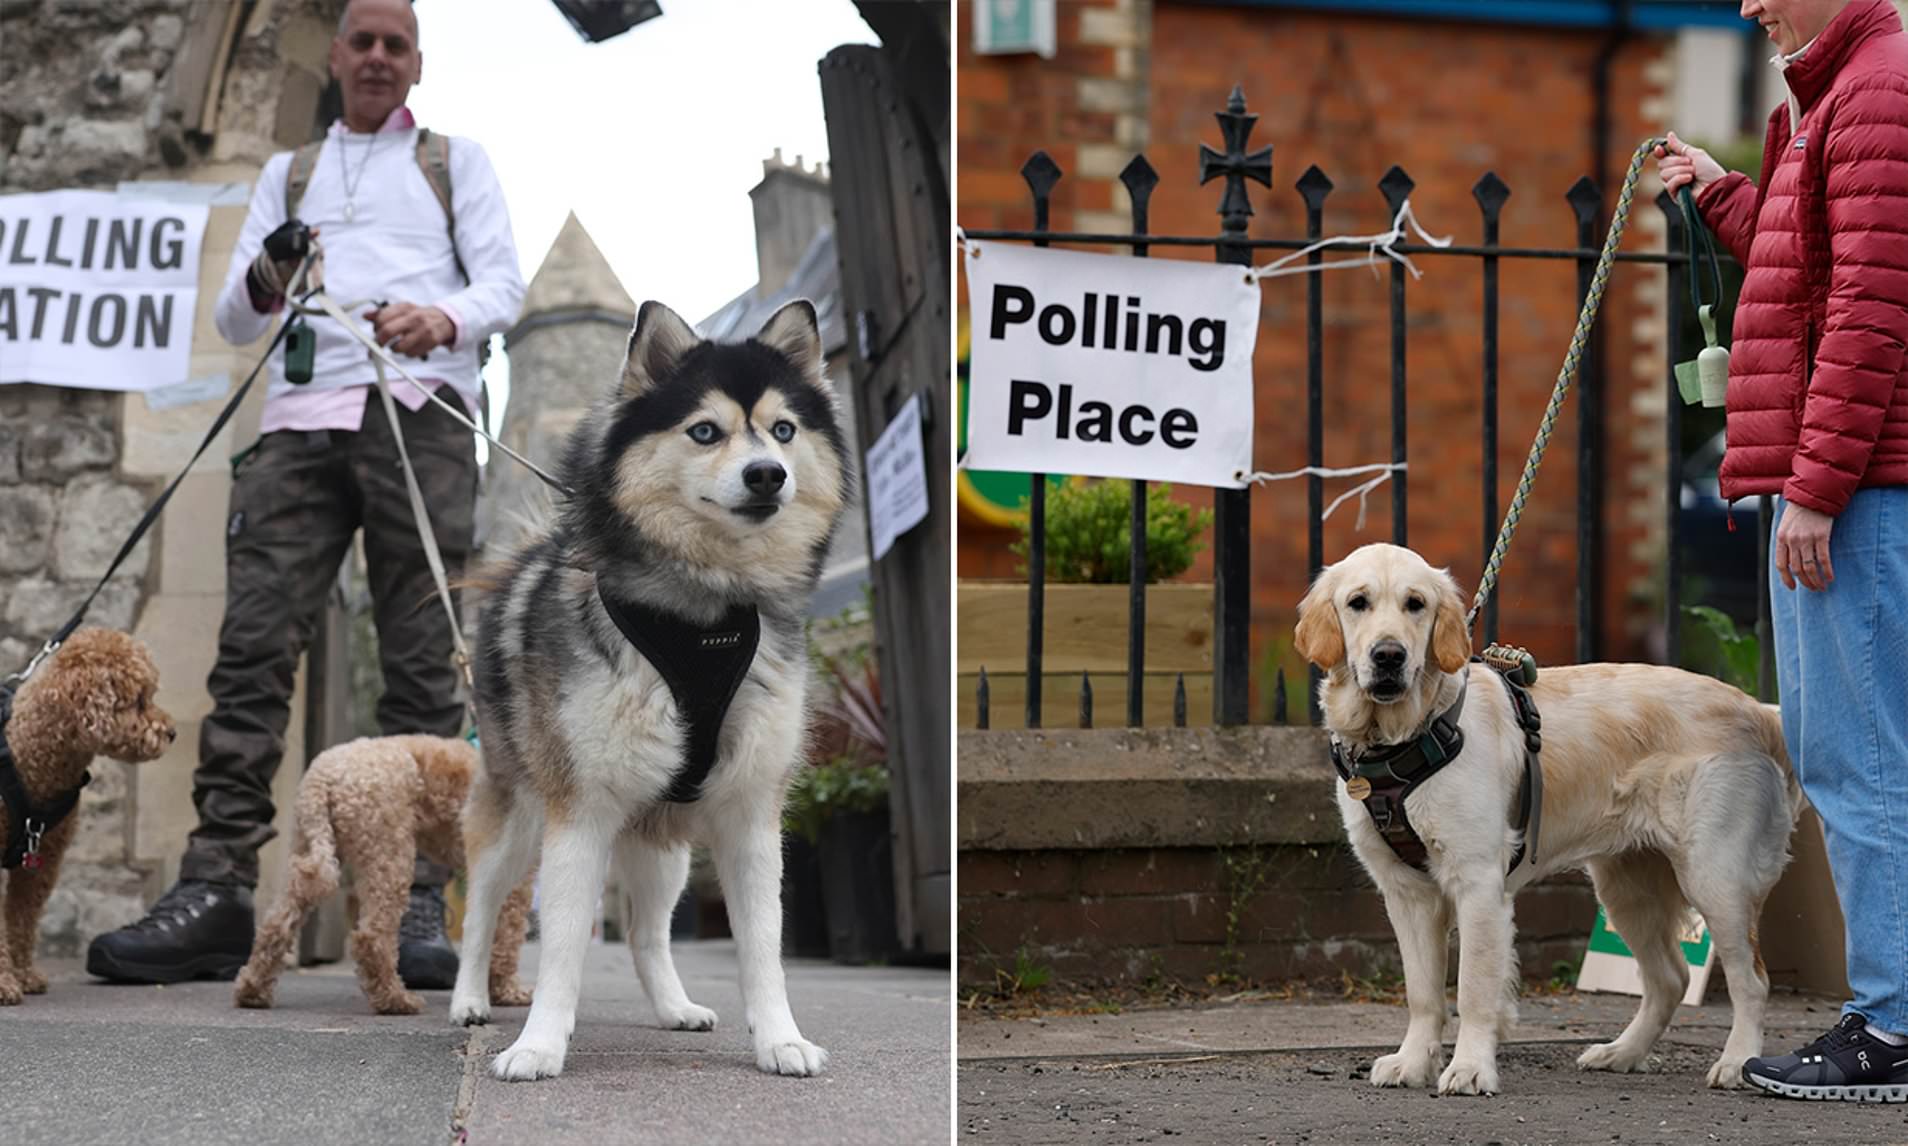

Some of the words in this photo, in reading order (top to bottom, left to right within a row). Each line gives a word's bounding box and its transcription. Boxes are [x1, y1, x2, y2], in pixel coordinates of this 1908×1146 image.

[0, 216, 185, 270] LLING
[989, 283, 1227, 372] Polling
[1007, 379, 1199, 450] Place
